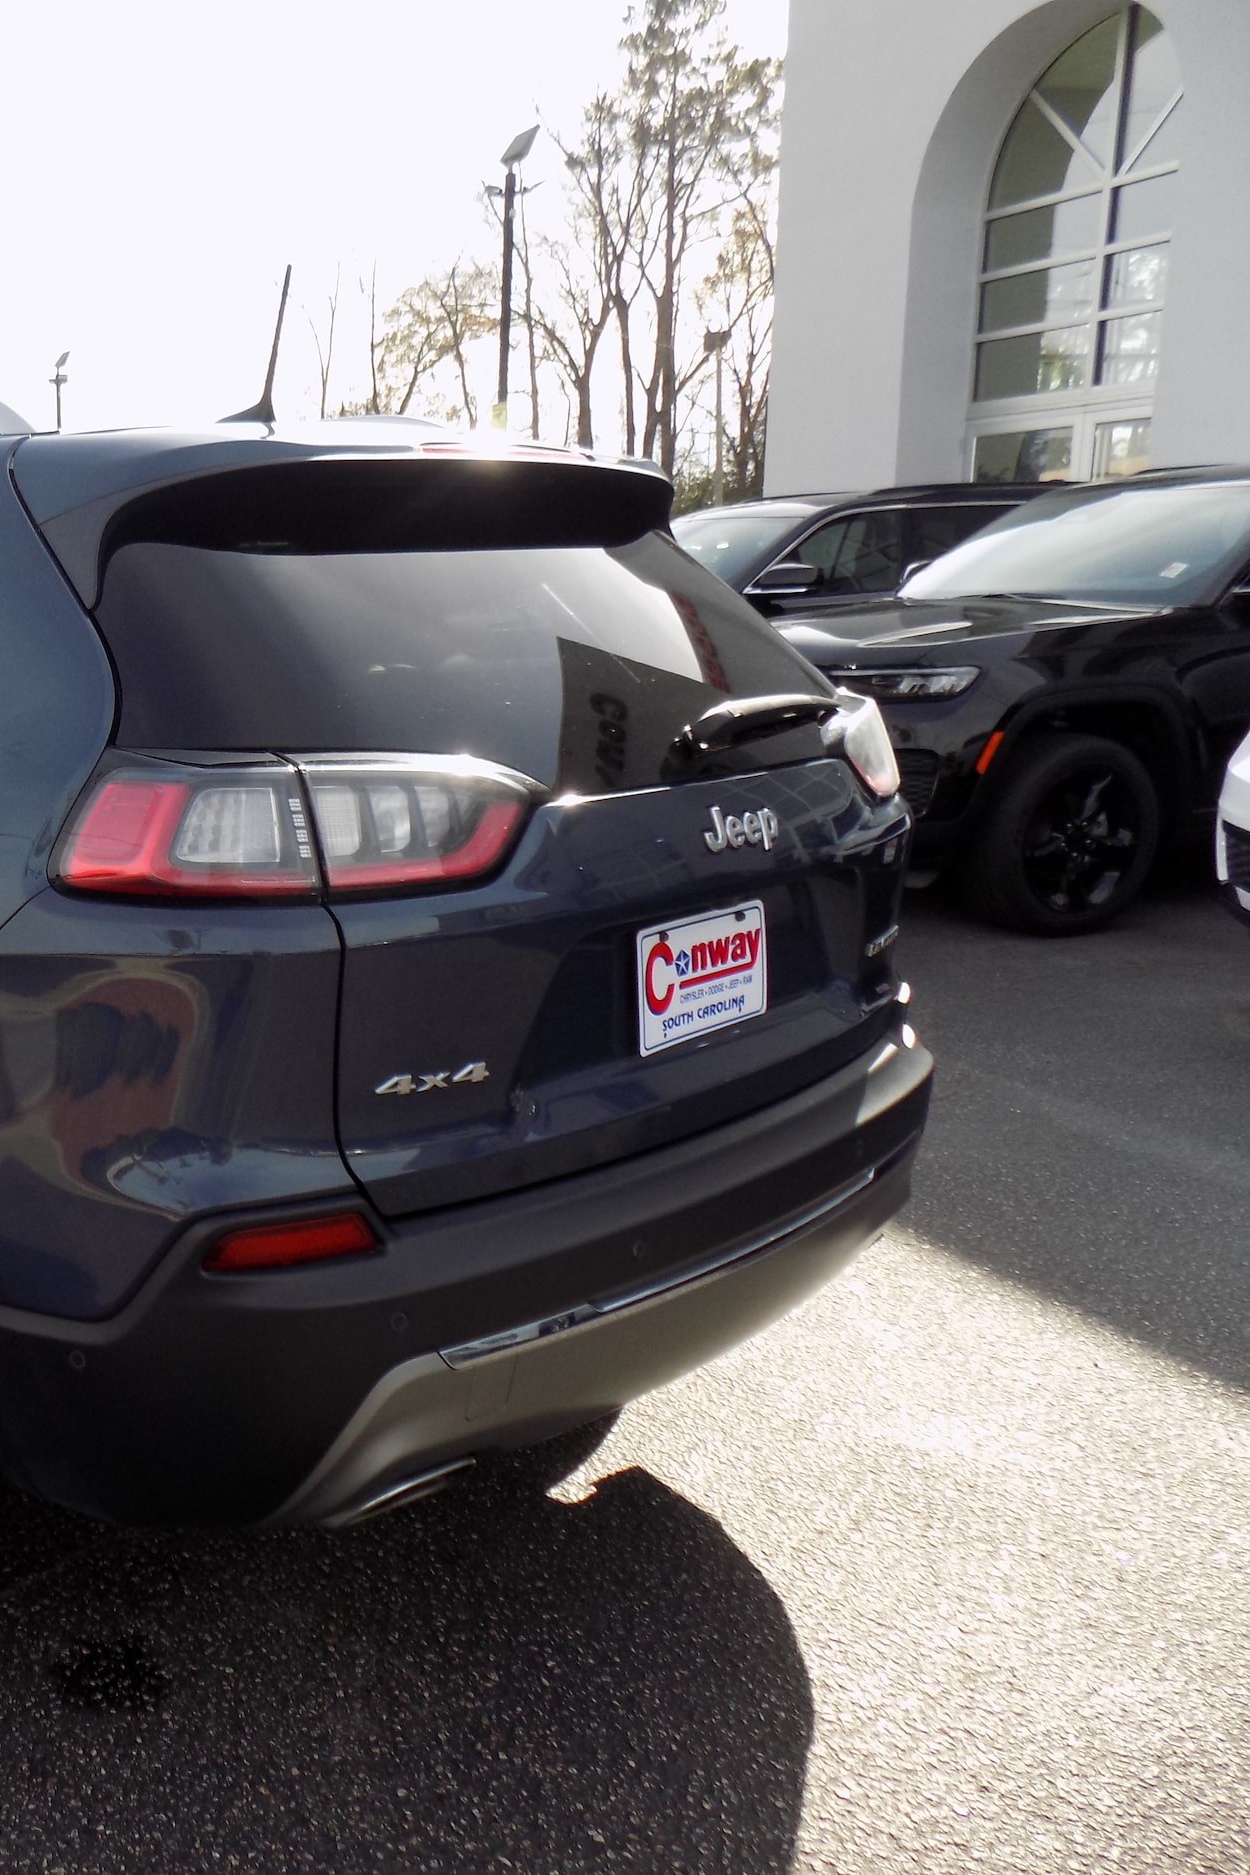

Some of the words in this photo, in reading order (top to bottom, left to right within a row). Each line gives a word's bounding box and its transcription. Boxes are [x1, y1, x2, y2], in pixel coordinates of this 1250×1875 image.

[703, 806, 779, 853] Jeep
[644, 928, 761, 1016] Conway
[680, 988, 705, 1004] CHRYSLER
[707, 984, 725, 997] DODGE
[728, 978, 739, 992] JEEP
[742, 974, 753, 986] RAM
[662, 1009, 694, 1031] SOUTH
[697, 994, 746, 1020] CAROLINA
[374, 1061, 490, 1095] 4x4
